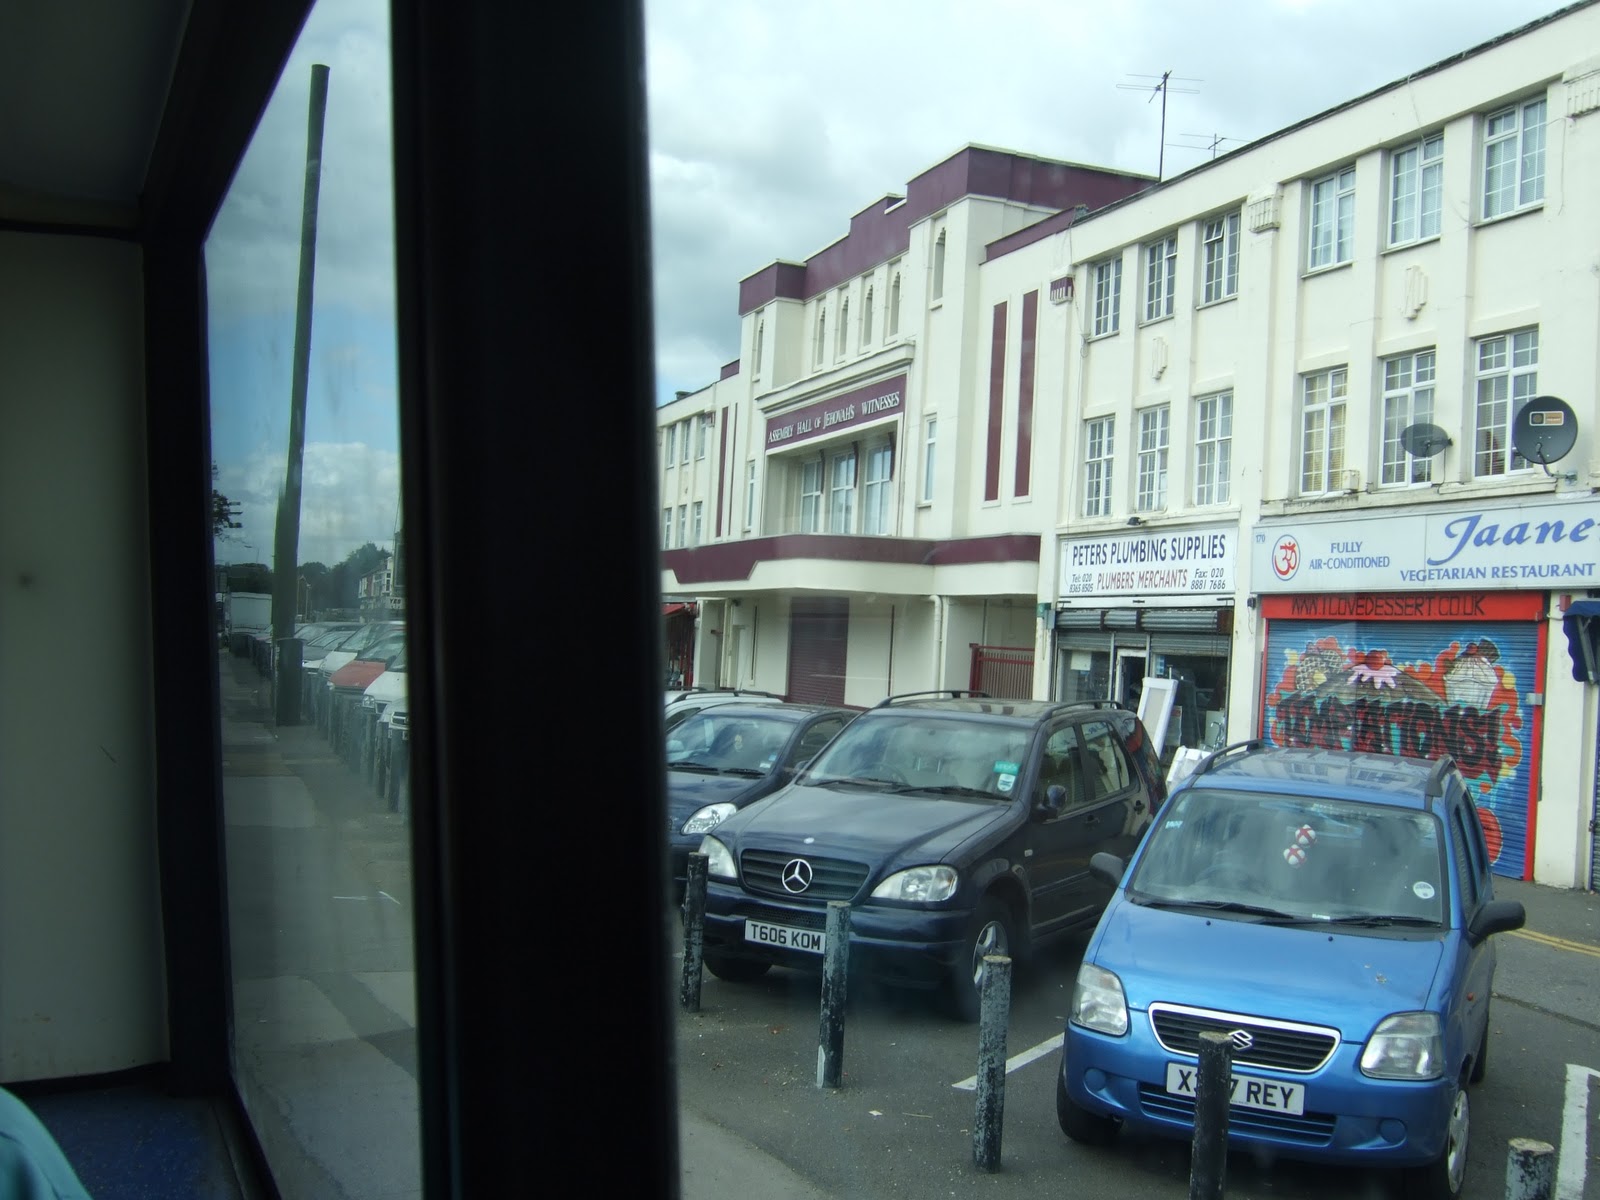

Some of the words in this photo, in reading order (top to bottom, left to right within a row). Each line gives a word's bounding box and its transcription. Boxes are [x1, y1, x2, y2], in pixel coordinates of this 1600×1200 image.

[768, 424, 794, 443] ASSEMBLY
[797, 418, 812, 435] HALL
[814, 417, 821, 428] OF
[823, 404, 855, 429] JEHOVAH'S
[862, 391, 900, 415] WITNESSES
[1256, 534, 1266, 543] 170
[1330, 541, 1363, 553] FULLY
[1427, 514, 1600, 566] Jaane
[1072, 543, 1107, 566] PETERS
[1110, 538, 1167, 564] PLUMBING
[1170, 534, 1225, 561] SUPPLIES
[1309, 556, 1390, 570] AIR-CONDITIONED
[1400, 567, 1487, 582] VEGETARIAN
[1491, 563, 1596, 579] RESTAURANT
[1082, 573, 1092, 583] 020
[1137, 568, 1188, 589] MERCHANTS
[1211, 568, 1224, 578] 020
[1191, 580, 1206, 590] 8881
[1209, 579, 1226, 590] 7686
[751, 924, 786, 945] T606
[791, 931, 821, 951] KOM
[1246, 1081, 1295, 1110] REY
